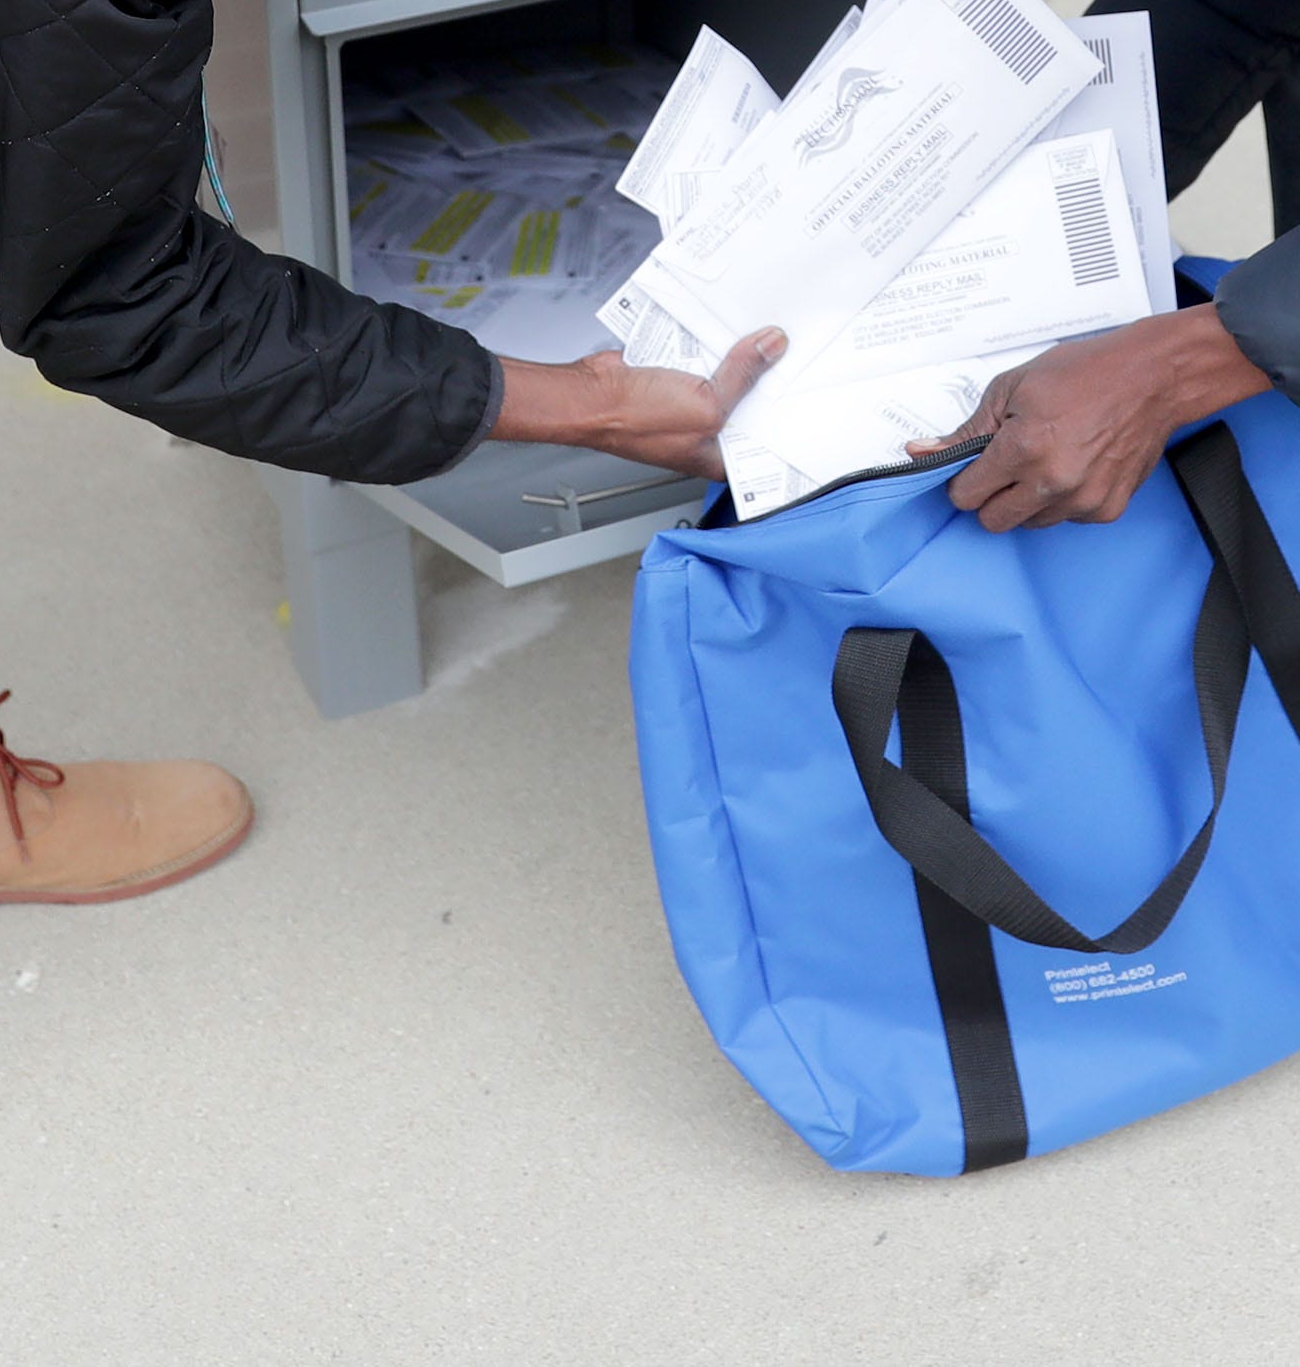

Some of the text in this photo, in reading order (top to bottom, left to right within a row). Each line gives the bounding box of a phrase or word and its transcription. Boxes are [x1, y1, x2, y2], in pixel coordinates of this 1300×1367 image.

[809, 187, 855, 232] OFFICIAL
[852, 136, 908, 190] BALLOTING
[905, 92, 953, 138] MATERIAL
[847, 176, 895, 224] BUSINESS
[891, 147, 925, 180] REPLY
[921, 125, 948, 151] MAIL
[948, 244, 1009, 266] MATERIAL
[916, 277, 953, 294] REPLY
[956, 270, 984, 285] MAIL
[1044, 961, 1111, 981] Printelect
[1053, 971, 1188, 1004] www.printelect.com
